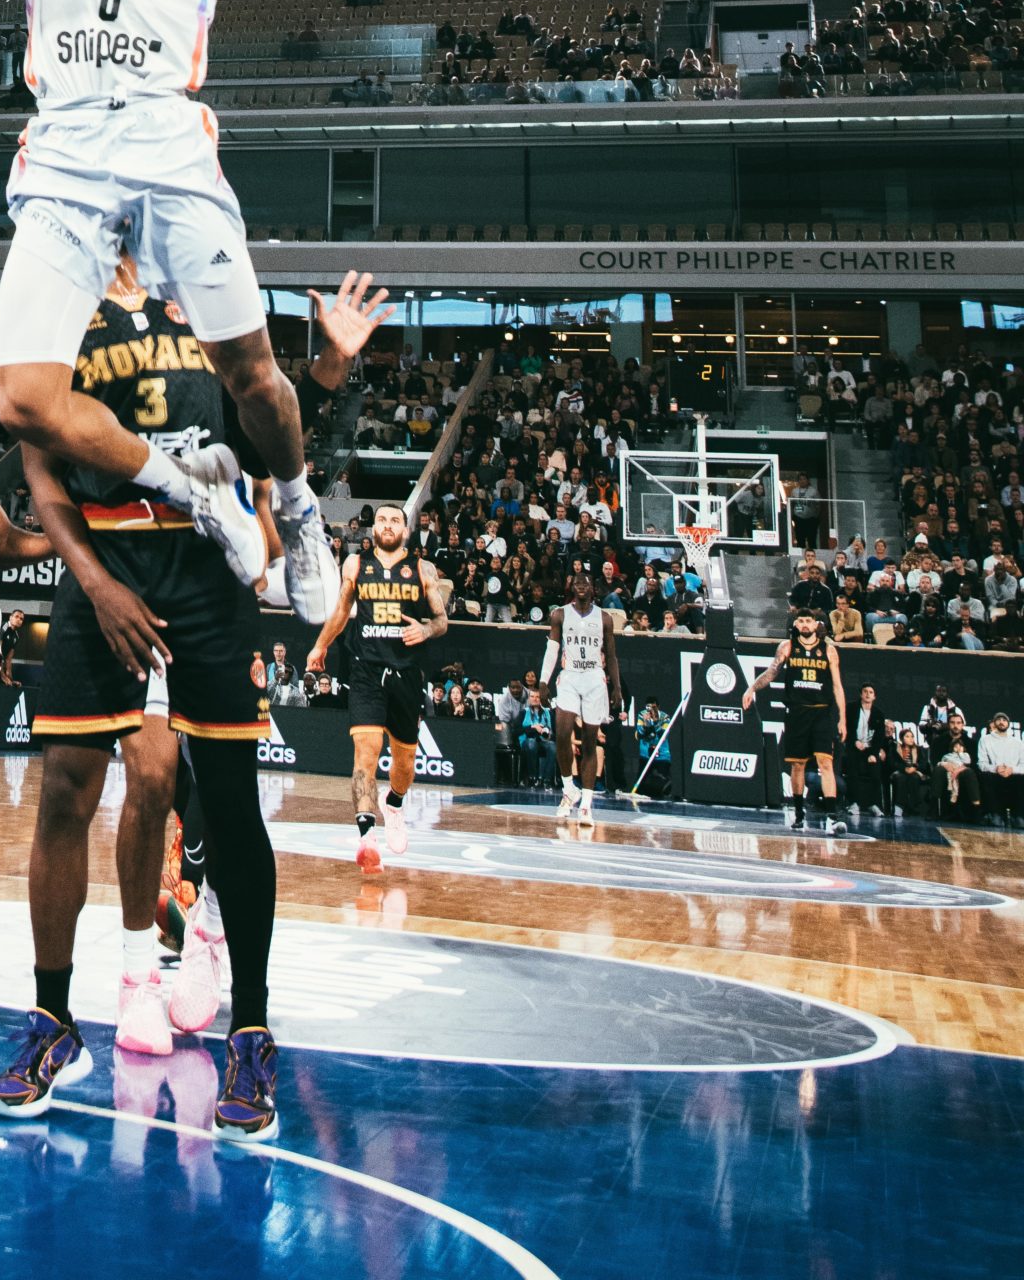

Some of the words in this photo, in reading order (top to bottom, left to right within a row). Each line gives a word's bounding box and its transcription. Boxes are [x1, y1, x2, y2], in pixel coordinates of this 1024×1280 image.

[56, 27, 148, 68] snipes
[578, 250, 668, 272] COURT
[676, 250, 794, 271] PHILIPPE
[819, 250, 956, 272] CHATRIER
[134, 377, 168, 427] 3
[358, 582, 419, 602] MONACO
[373, 602, 401, 623] 55
[567, 635, 599, 647] PARIS
[580, 646, 586, 659] 8
[789, 656, 827, 669] MONACO
[801, 668, 817, 681] 18
[703, 708, 739, 722] Betclic
[5, 724, 31, 743] adidas
[257, 740, 296, 764] das
[378, 753, 455, 777] adas
[698, 754, 749, 773] GORILLAS
